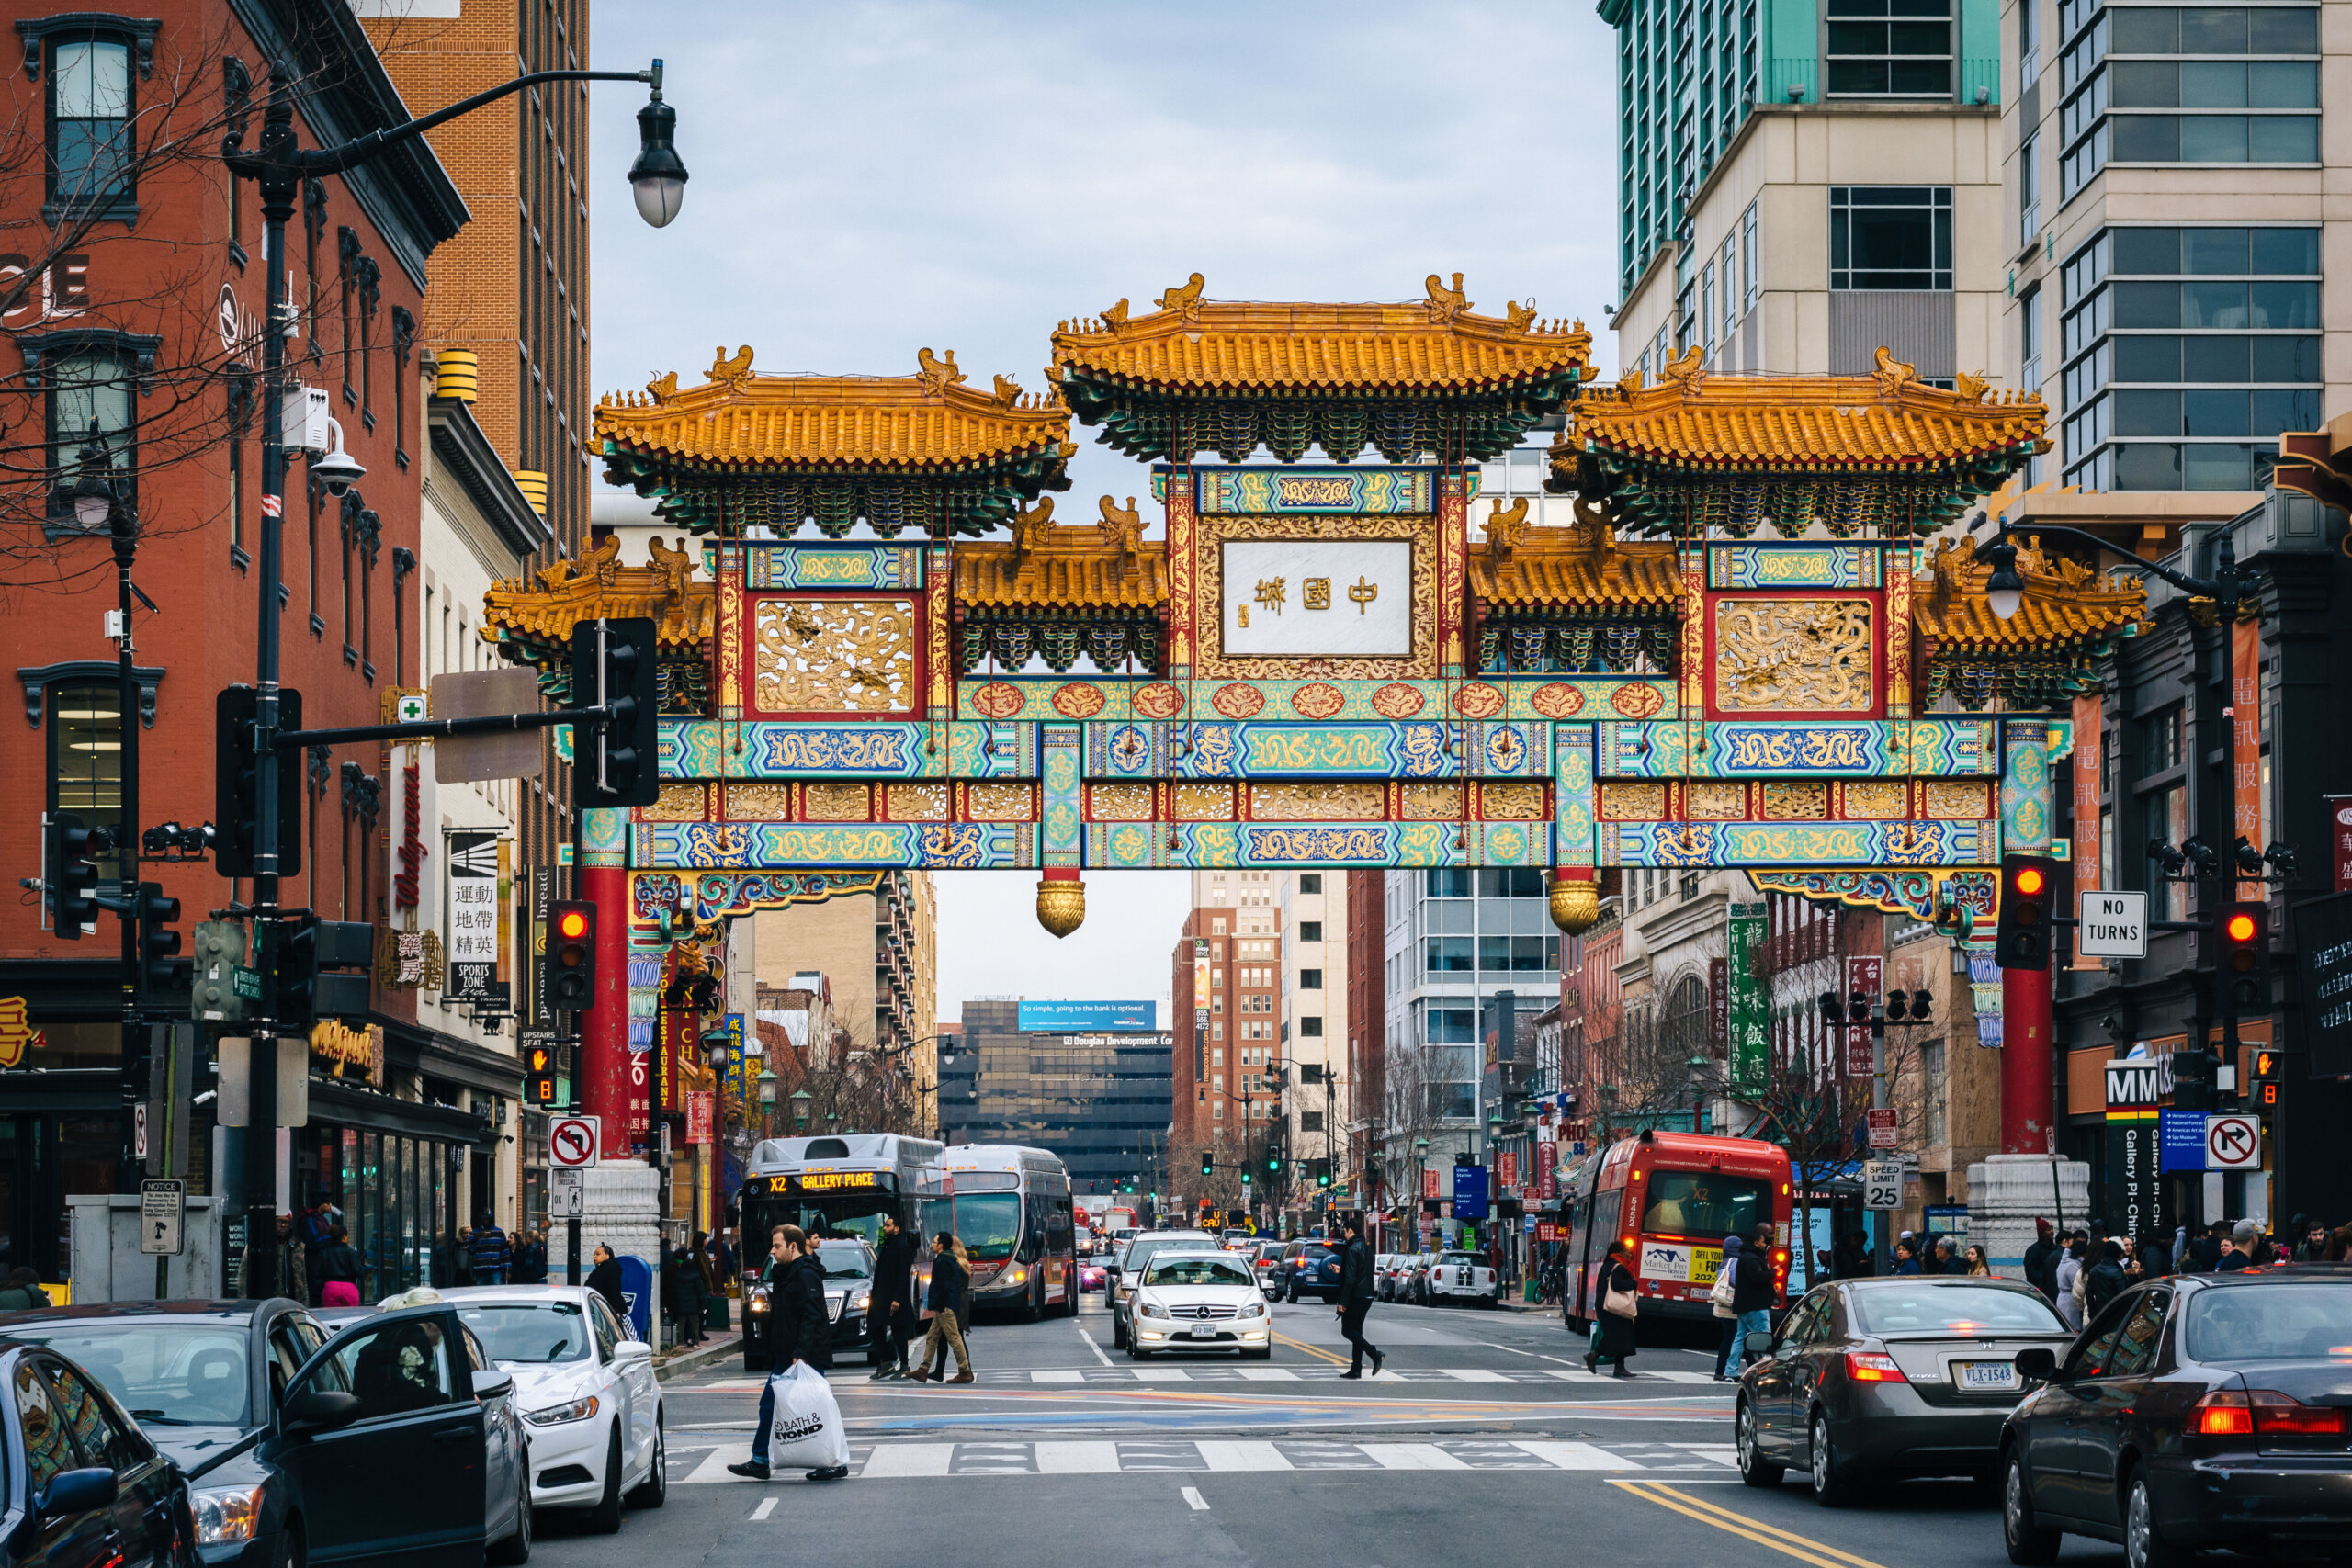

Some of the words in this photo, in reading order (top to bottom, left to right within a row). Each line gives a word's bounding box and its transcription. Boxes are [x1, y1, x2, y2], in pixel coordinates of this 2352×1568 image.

[394, 761, 428, 909] Walgreens
[455, 886, 493, 904] 運動
[2103, 900, 2124, 915] NO
[455, 910, 493, 929] 地帶
[2089, 924, 2138, 940] TURNS
[455, 935, 493, 954] 精英
[458, 964, 490, 976] SPORTS
[1731, 923, 1740, 1014] CHINATOWN
[463, 976, 485, 988] ZONE
[1033, 1005, 1055, 1013] simple,
[1118, 1005, 1146, 1013] optional.
[1074, 1036, 1105, 1047] Douglas
[1106, 1036, 1158, 1047] Development
[539, 1080, 551, 1100] 8
[2107, 1070, 2136, 1103] M
[2139, 1069, 2157, 1102] M
[2265, 1085, 2276, 1104] 8
[1558, 1125, 1587, 1142] PHO
[1573, 1142, 1585, 1155] 88
[2125, 1129, 2138, 1179] Gallery
[1869, 1166, 1900, 1174] SPEED
[147, 1182, 175, 1190] NOTICE
[770, 1177, 786, 1192] X2
[802, 1175, 842, 1189] GALLERY
[844, 1173, 874, 1186] PLACE
[1872, 1175, 1895, 1183] LIMIT
[554, 1195, 561, 1204] OK
[1692, 1187, 1709, 1201] X2
[1871, 1187, 1898, 1206] 25
[1628, 1196, 1638, 1228] 5452
[1695, 1249, 1709, 1259] SELL
[1644, 1259, 1671, 1269] Market
[1694, 1273, 1717, 1281] 202-
[1965, 1369, 2012, 1382] VLX-1548
[784, 1416, 811, 1431] BATH
[812, 1412, 821, 1423] &
[775, 1423, 824, 1441] EYOND
